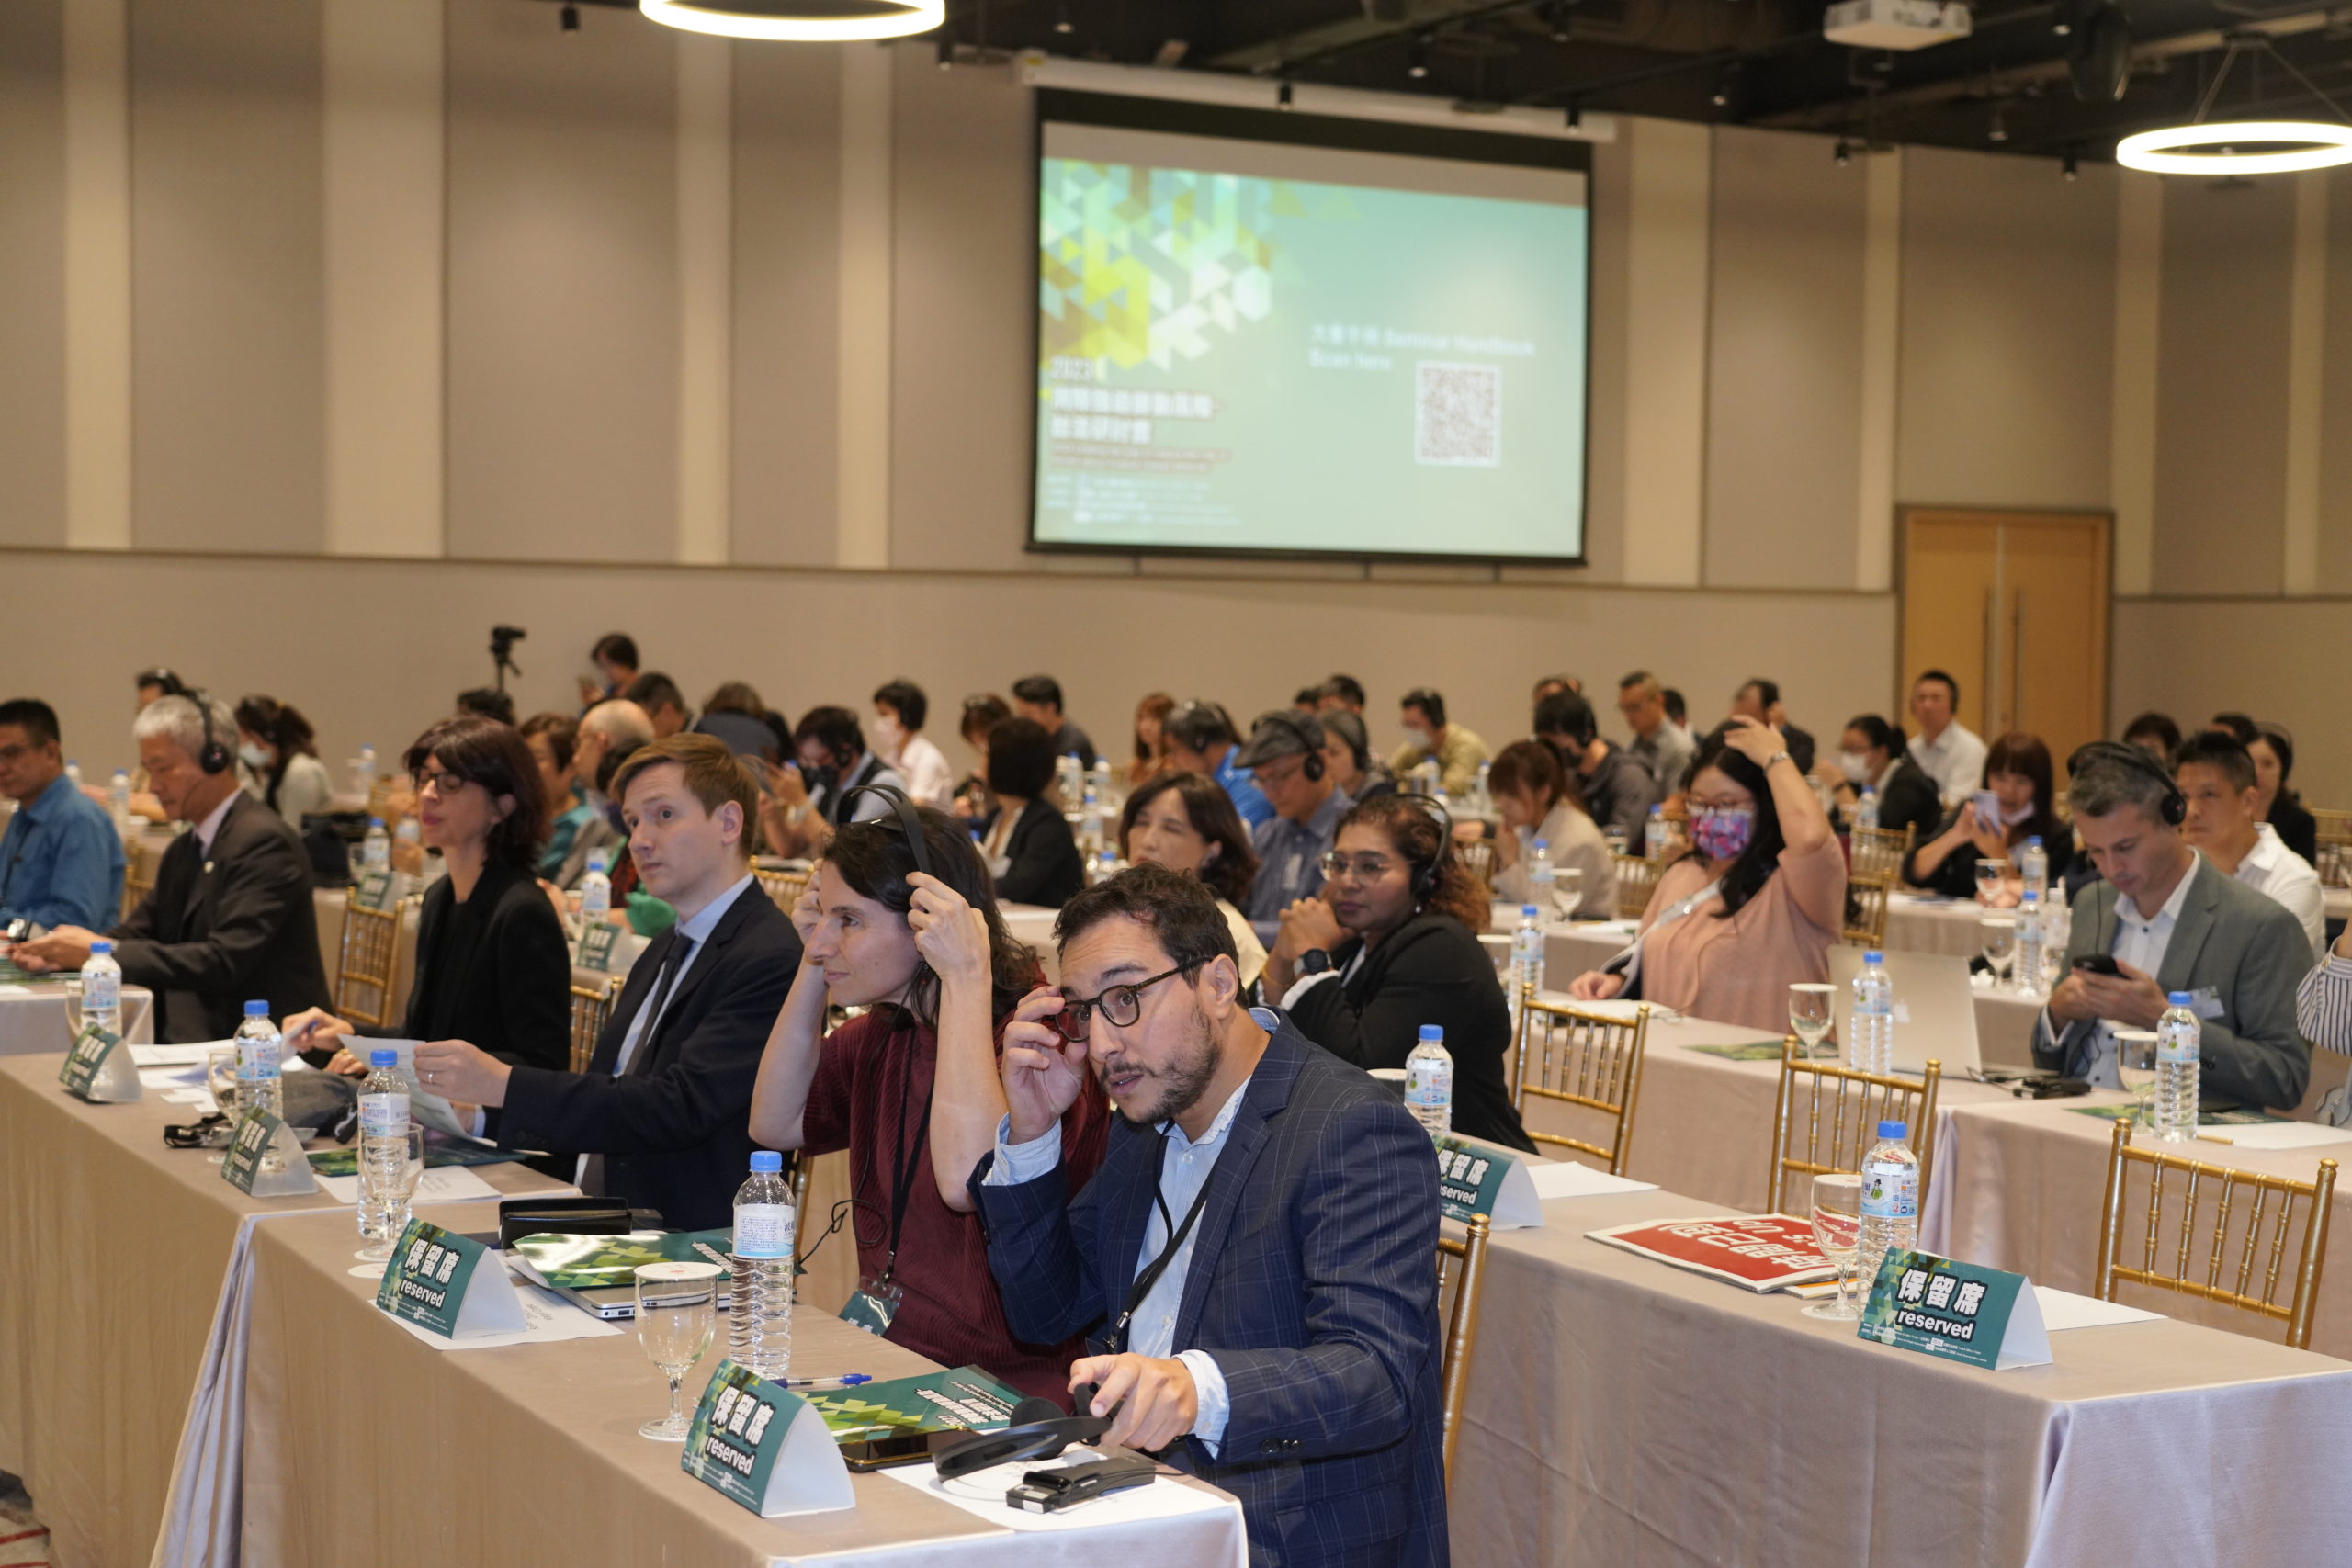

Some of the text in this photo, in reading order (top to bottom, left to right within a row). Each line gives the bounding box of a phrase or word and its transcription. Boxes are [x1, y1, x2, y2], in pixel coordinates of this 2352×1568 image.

[1440, 1185, 1477, 1205] served
[404, 1237, 461, 1284] 保留席
[400, 1278, 447, 1308] reserved
[1897, 1269, 1986, 1315] 保留席
[1897, 1309, 1974, 1339] reserved
[711, 1385, 775, 1445] 保留席
[707, 1436, 755, 1476] reserved
